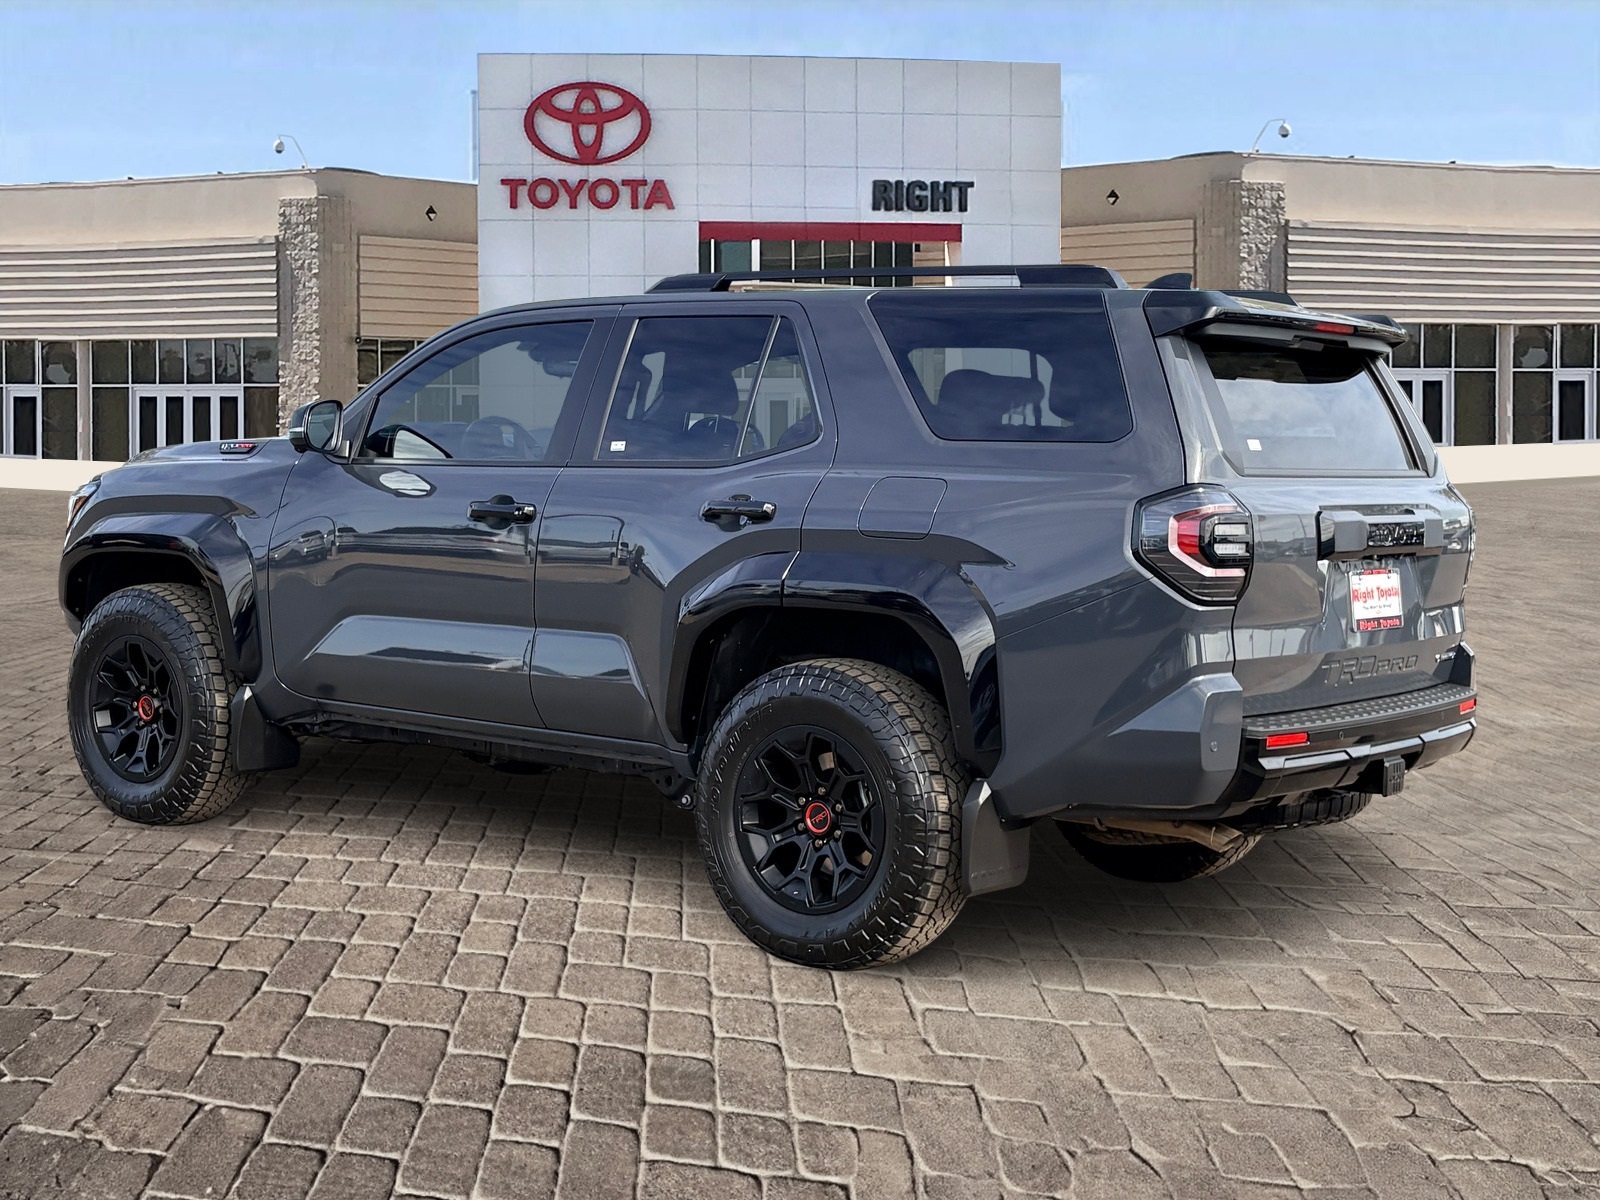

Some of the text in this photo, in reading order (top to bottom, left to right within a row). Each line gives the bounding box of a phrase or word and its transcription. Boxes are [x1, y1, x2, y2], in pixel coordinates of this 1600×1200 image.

[500, 178, 675, 210] TOYOTA
[871, 179, 975, 213] RIGHT
[1352, 587, 1374, 604] Right
